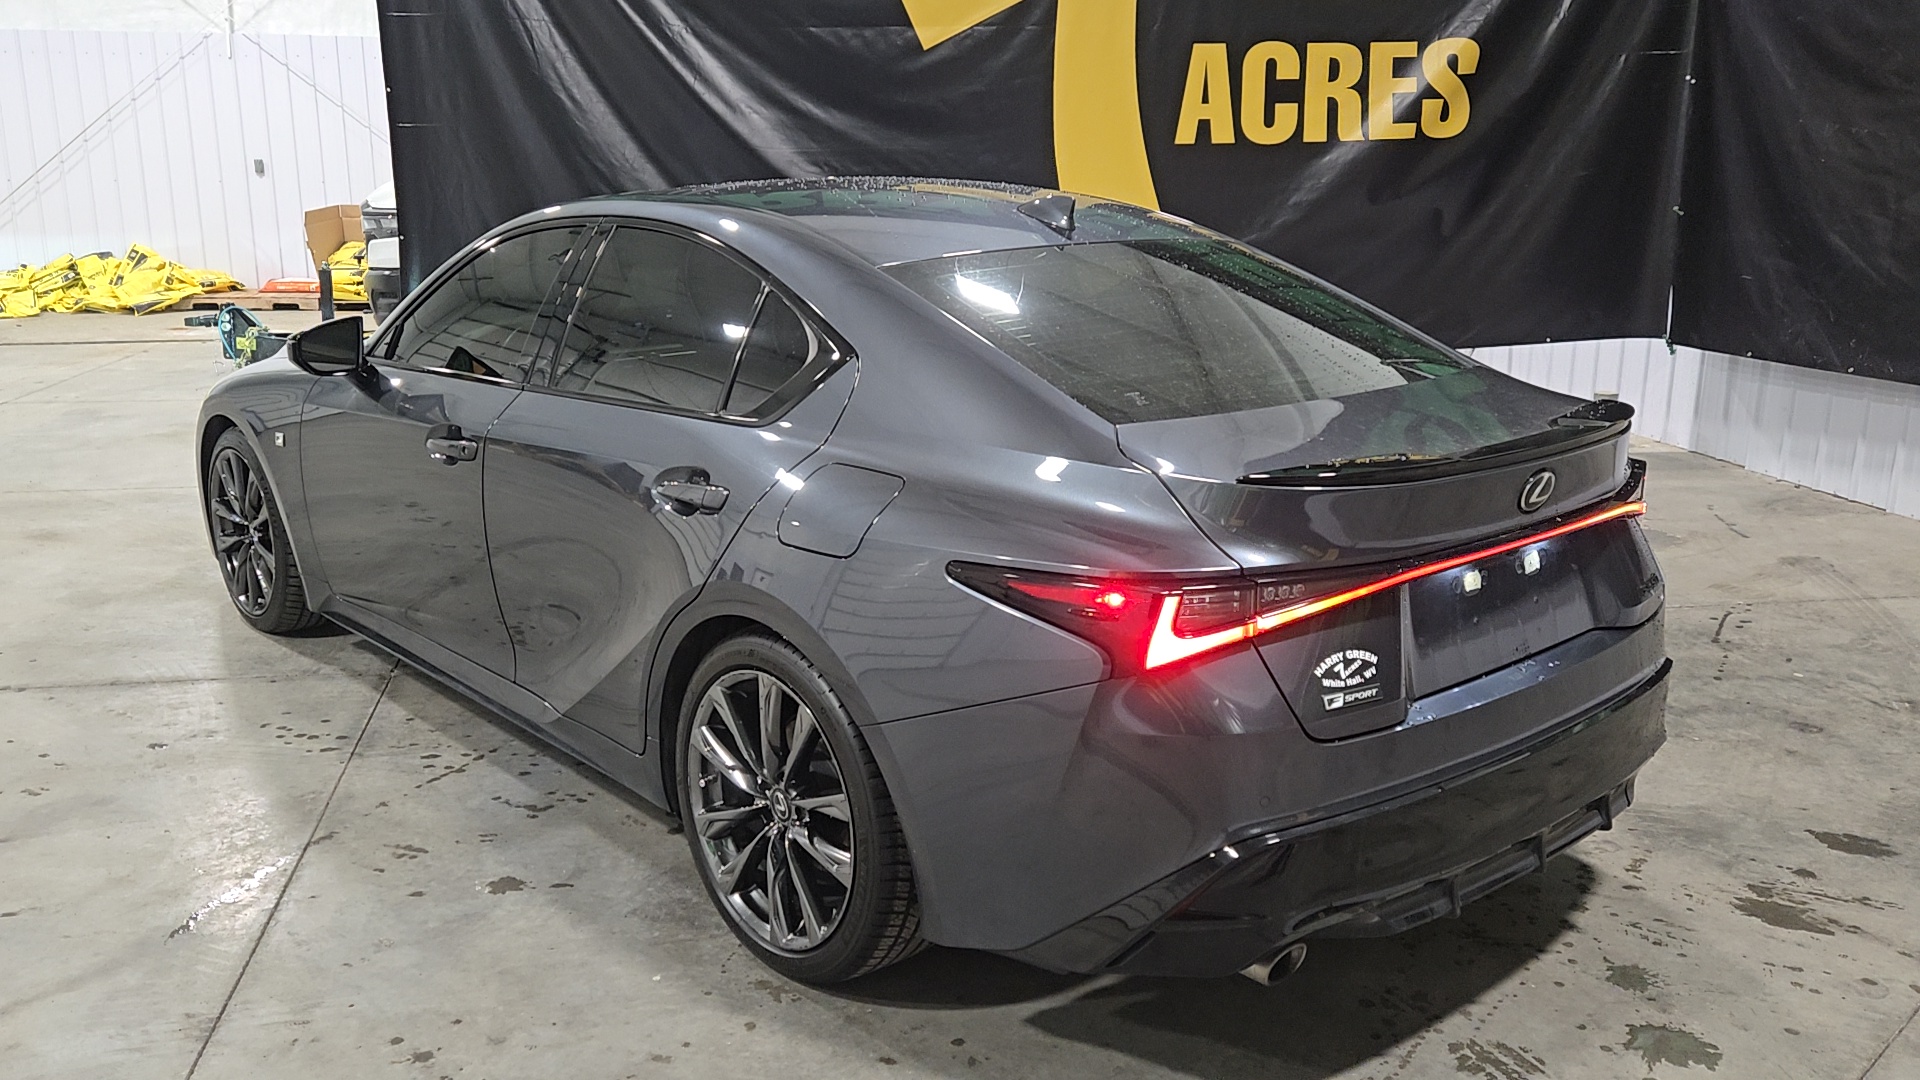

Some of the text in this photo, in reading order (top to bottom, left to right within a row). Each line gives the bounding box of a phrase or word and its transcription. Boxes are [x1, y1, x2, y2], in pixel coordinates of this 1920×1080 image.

[1174, 37, 1480, 144] ACRES
[1314, 649, 1378, 678] HARRY GREEN
[1333, 662, 1346, 679] 7
[1322, 678, 1345, 687] White
[1363, 665, 1376, 679] WV
[1344, 688, 1378, 702] SPORT
